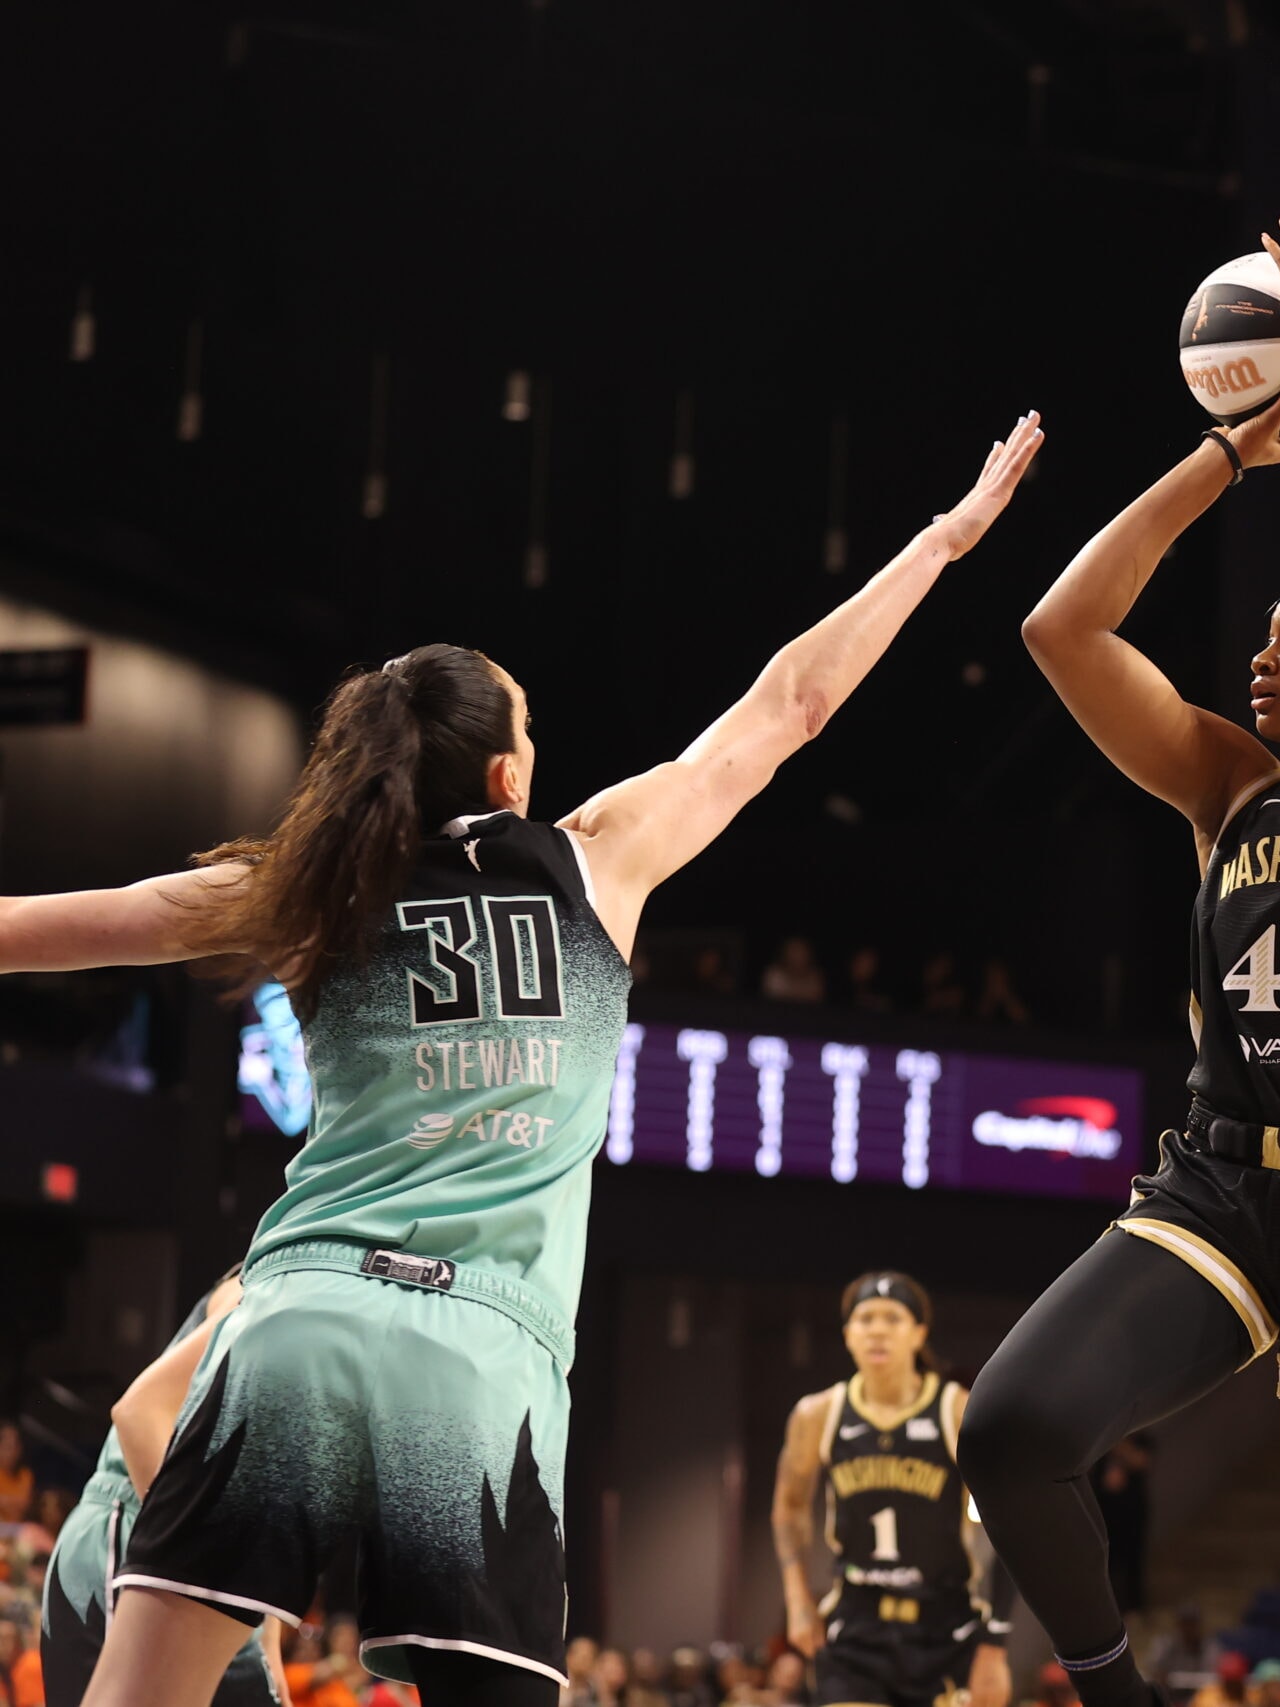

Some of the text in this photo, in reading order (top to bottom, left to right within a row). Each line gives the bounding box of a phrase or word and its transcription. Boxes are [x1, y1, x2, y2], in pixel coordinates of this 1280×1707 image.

[1185, 357, 1266, 398] Wilso
[395, 895, 566, 1029] 30
[415, 1038, 562, 1091] STEWART
[456, 1108, 555, 1149] AT&T
[869, 1506, 900, 1561] 1
